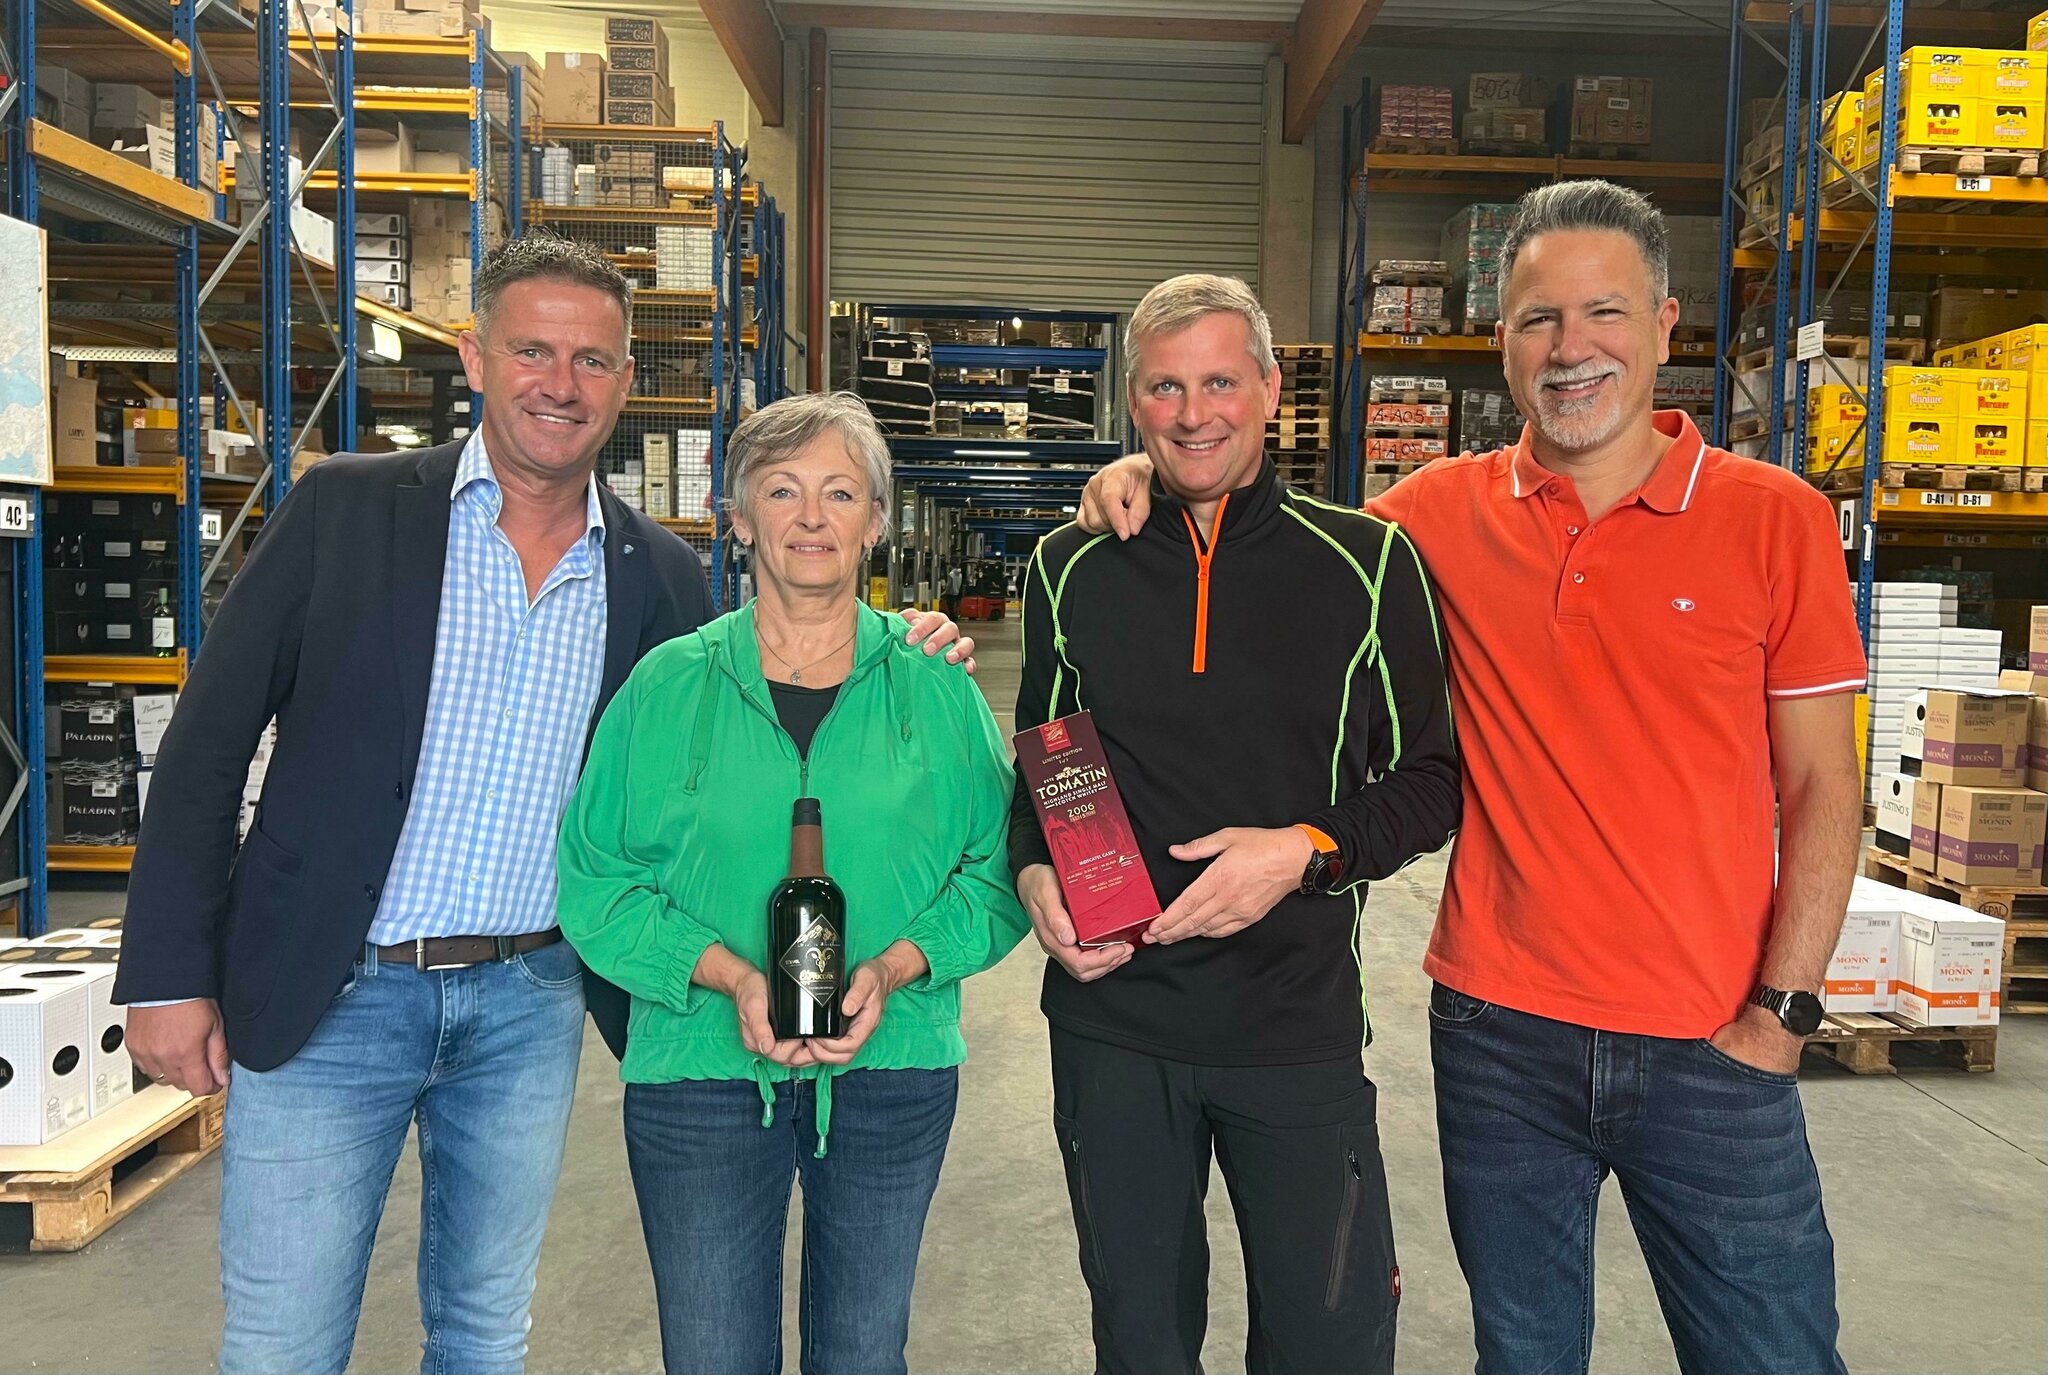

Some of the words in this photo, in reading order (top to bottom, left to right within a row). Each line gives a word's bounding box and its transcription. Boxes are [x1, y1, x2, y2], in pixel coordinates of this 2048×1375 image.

[1961, 179, 1980, 190] D-C1
[1926, 493, 1944, 504] D-A1
[1963, 495, 1981, 505] D-B1
[6, 506, 22, 526] 4C
[205, 520, 217, 534] 4D
[1842, 510, 1851, 541] D
[65, 732, 113, 742] PALADIN
[1927, 748, 1950, 761] MONIN
[1960, 750, 1996, 763] MONIN
[1036, 766, 1108, 800] TOMATIN
[1043, 792, 1072, 806] HIGHLAND
[1072, 785, 1092, 796] SINGLE
[1092, 780, 1107, 790] MALT
[1055, 796, 1077, 807] SCOTCH
[1077, 788, 1098, 799] WHISKY
[68, 805, 116, 816] PALADIN
[1067, 802, 1095, 818] 2006
[1978, 818, 2013, 826] MONIN
[1974, 849, 2011, 862] MONIN
[1940, 968, 1974, 976] MONIN
[1838, 983, 1864, 993] MONIN
[1941, 995, 1968, 1005] MONIN
